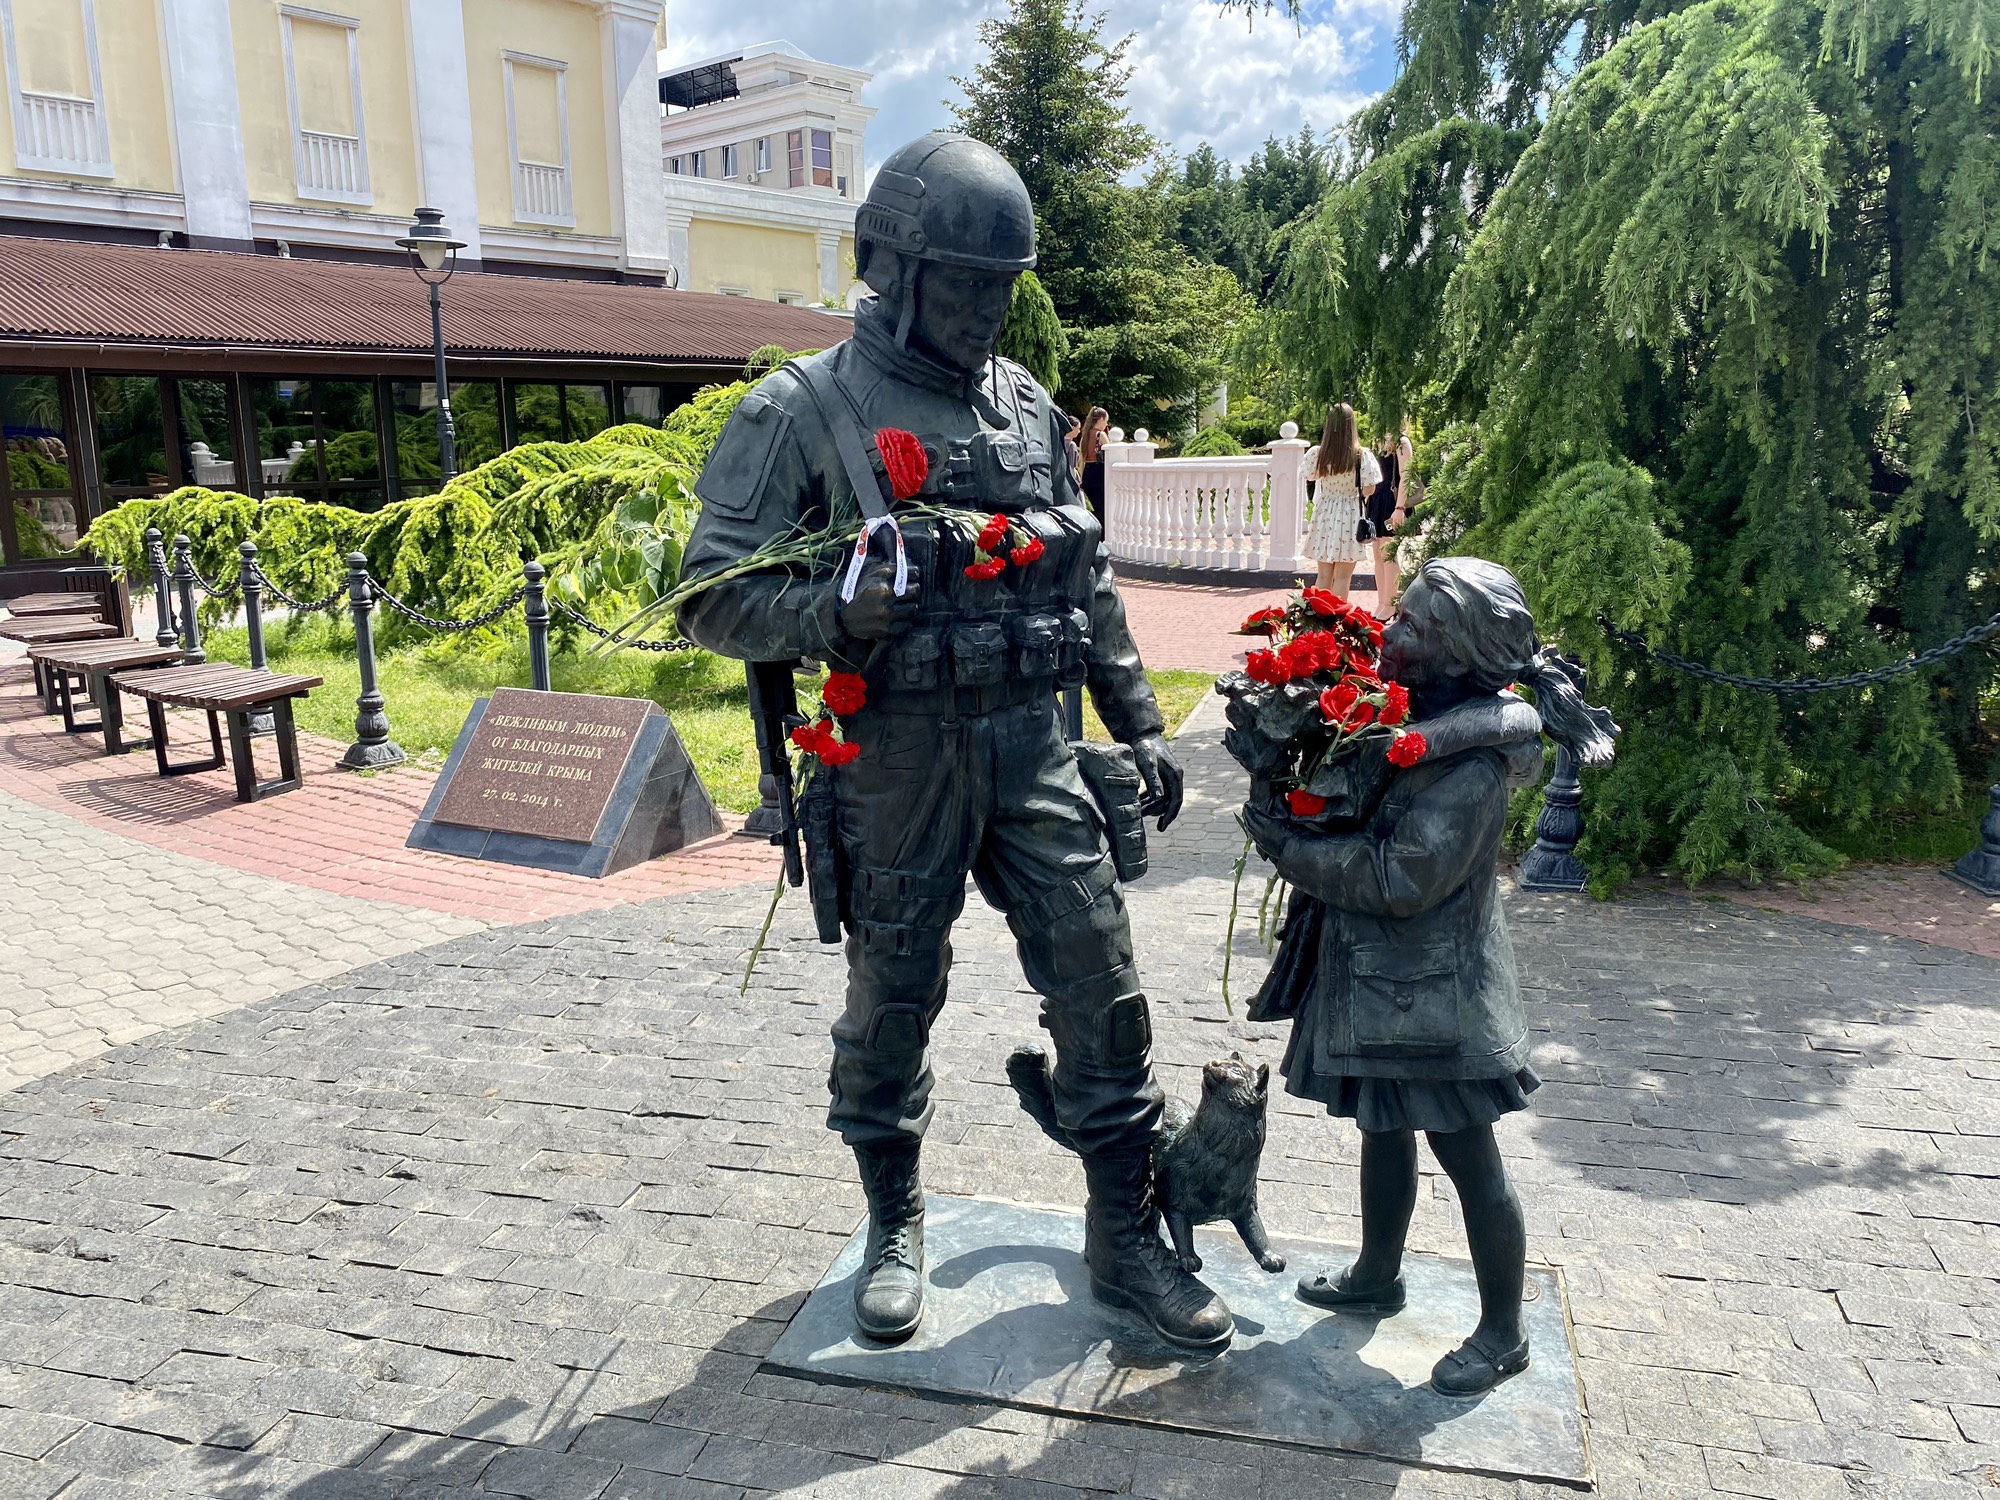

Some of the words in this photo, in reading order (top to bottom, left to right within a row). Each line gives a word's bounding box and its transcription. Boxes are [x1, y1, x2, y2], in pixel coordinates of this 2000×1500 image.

[490, 715, 568, 732] «ВЕЖЛИВЫМ
[571, 722, 627, 739] ЛЮДЯМ»
[492, 736, 509, 748] ОТ
[512, 738, 605, 760] БЛАГОДАРНЫХ
[481, 757, 543, 775] ЖИТЕЛЕЙ
[547, 764, 592, 782] КРЫМА
